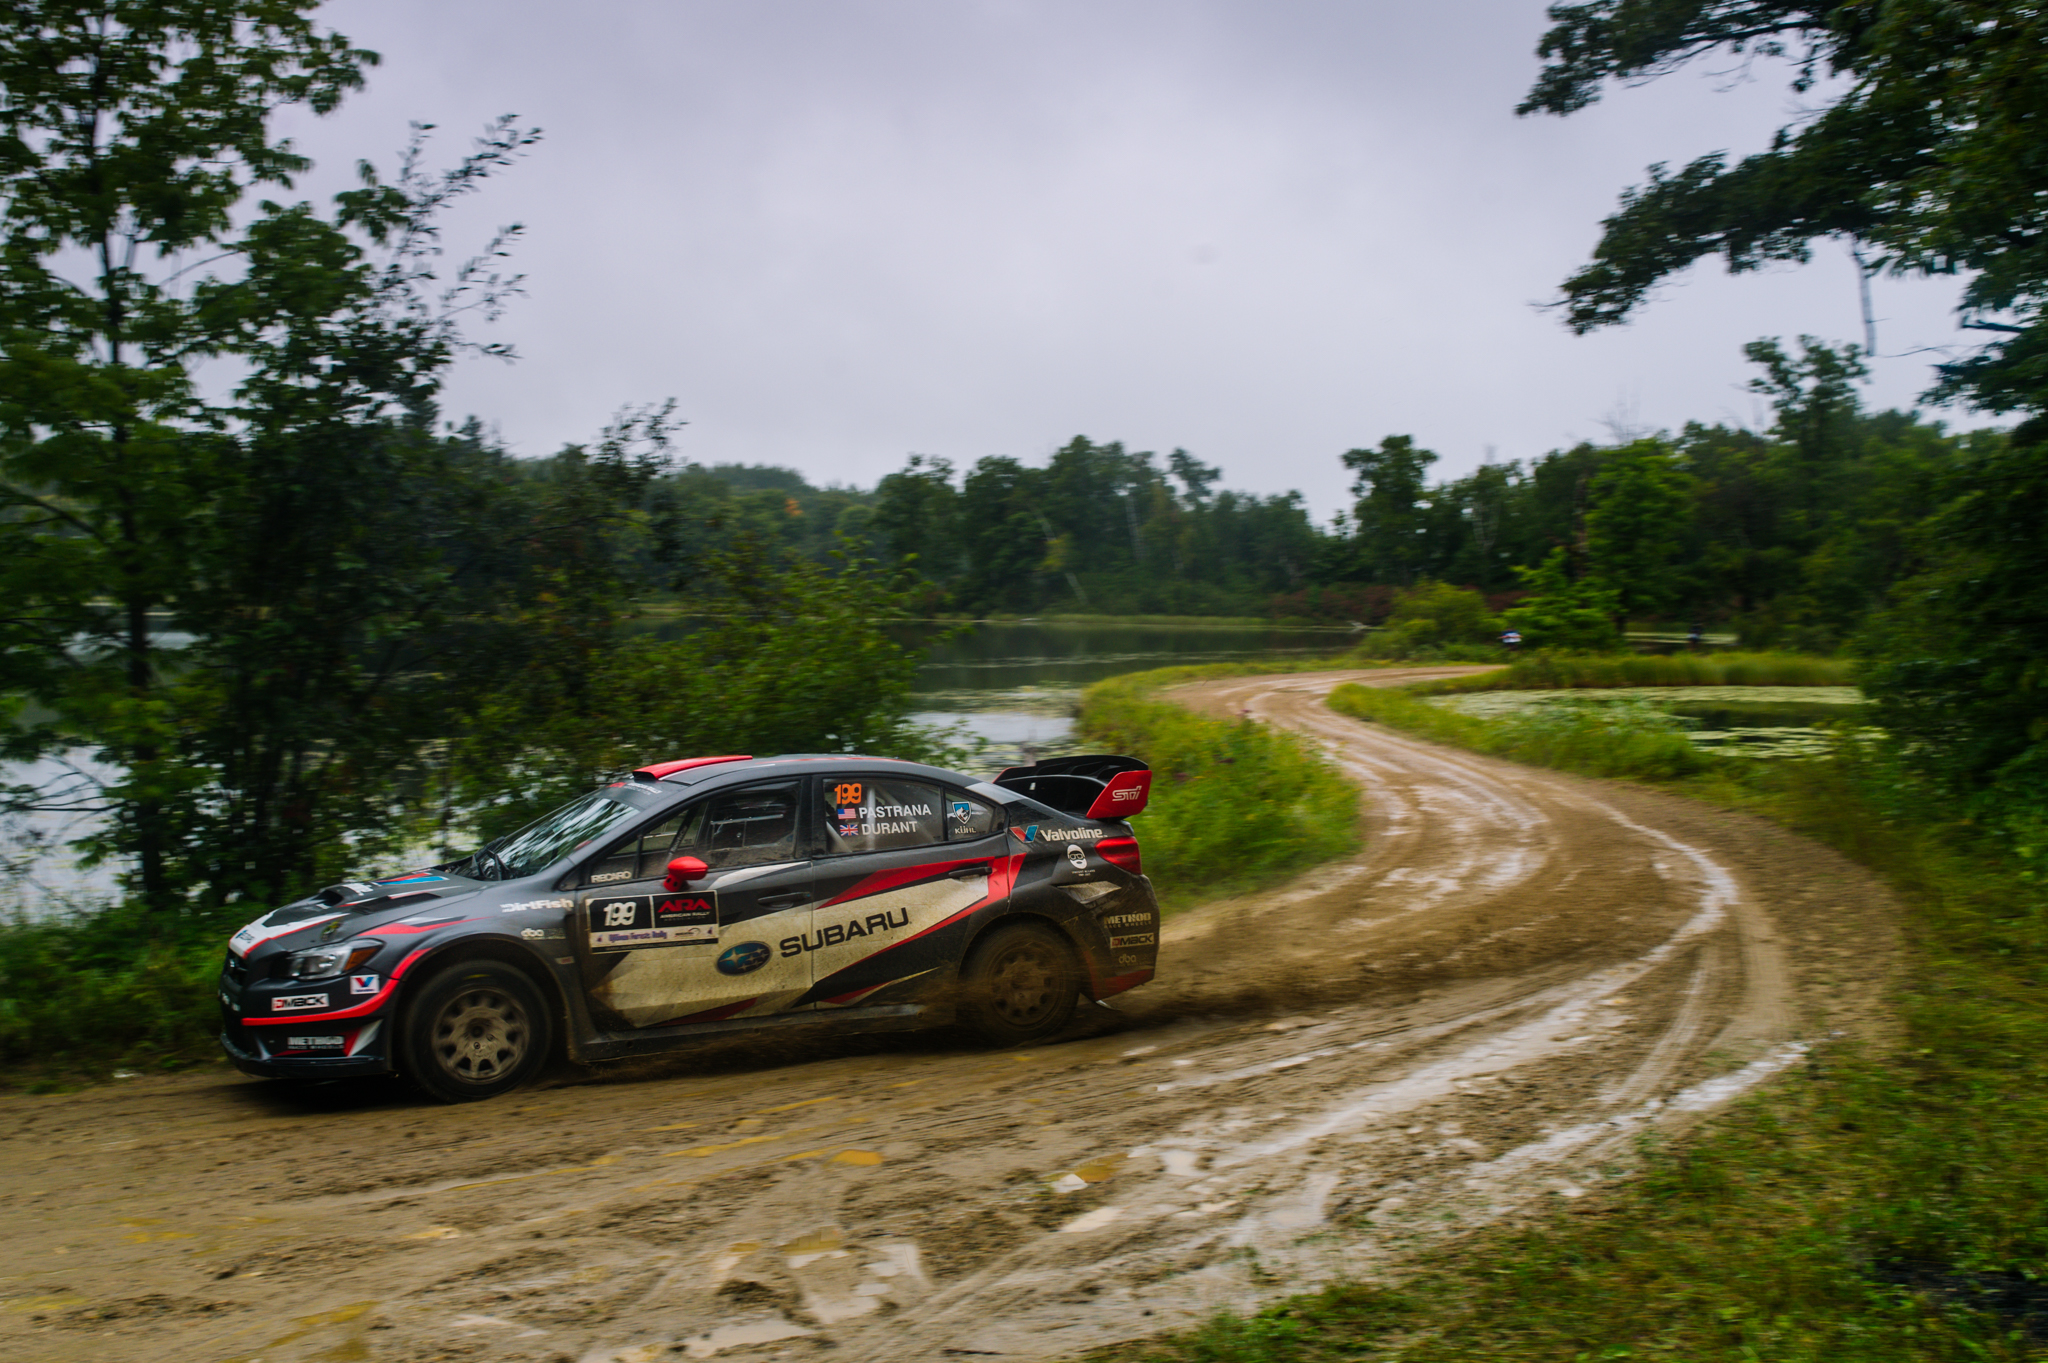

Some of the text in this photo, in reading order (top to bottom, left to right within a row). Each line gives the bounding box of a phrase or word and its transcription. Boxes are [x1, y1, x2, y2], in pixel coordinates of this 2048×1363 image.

[834, 783, 862, 804] 199
[858, 804, 932, 819] PASTRANA
[861, 821, 918, 836] DURANT
[1040, 827, 1105, 842] Valvoline
[591, 870, 632, 884] RECARO
[657, 898, 712, 913] ARA
[603, 901, 637, 927] 199
[1103, 911, 1152, 925] METHOD
[779, 907, 910, 958] SUBARU
